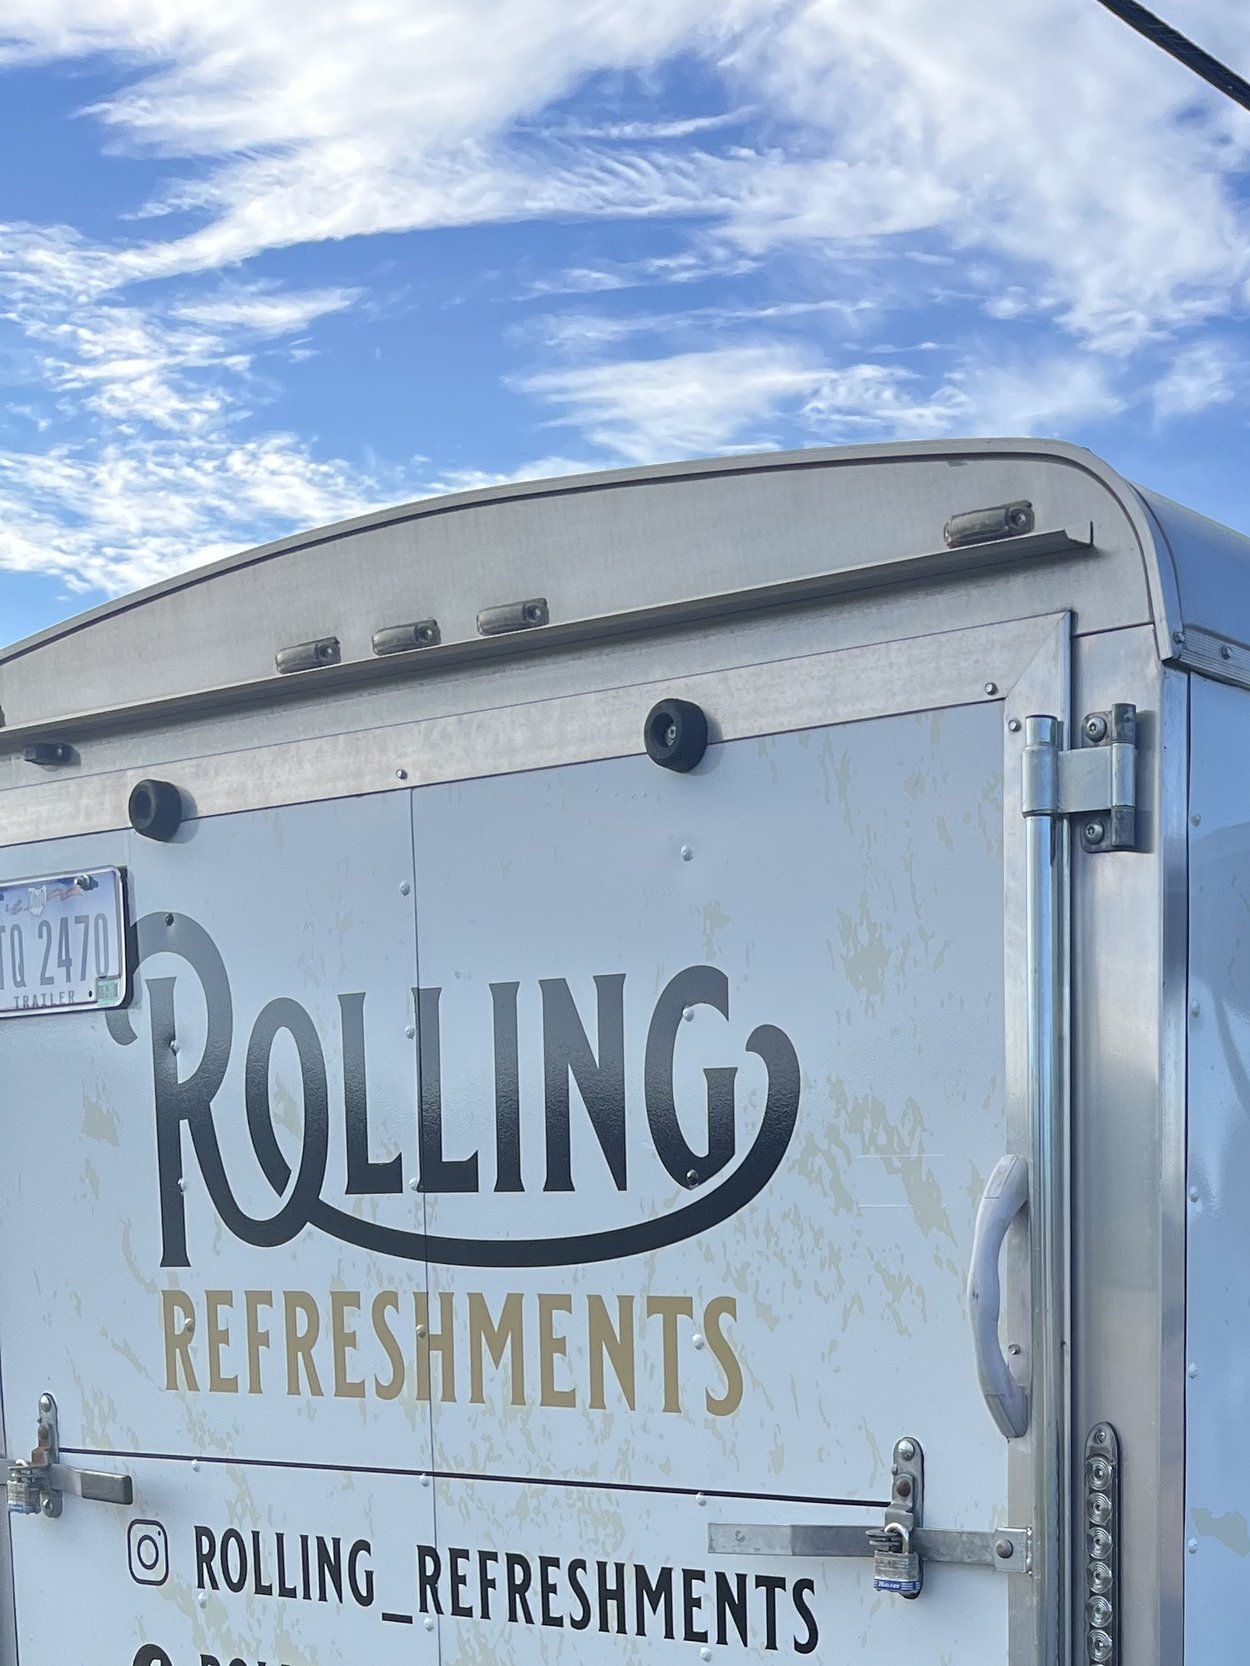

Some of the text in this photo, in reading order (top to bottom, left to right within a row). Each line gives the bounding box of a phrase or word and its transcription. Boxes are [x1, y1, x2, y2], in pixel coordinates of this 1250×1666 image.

[14, 990, 75, 1010] TRAILER
[38, 912, 110, 986] 2470
[105, 911, 800, 1268] ROLLING
[160, 1290, 744, 1416] REFRESHMENTS
[194, 1525, 820, 1654] ROLLING_REFRESHMENTS
